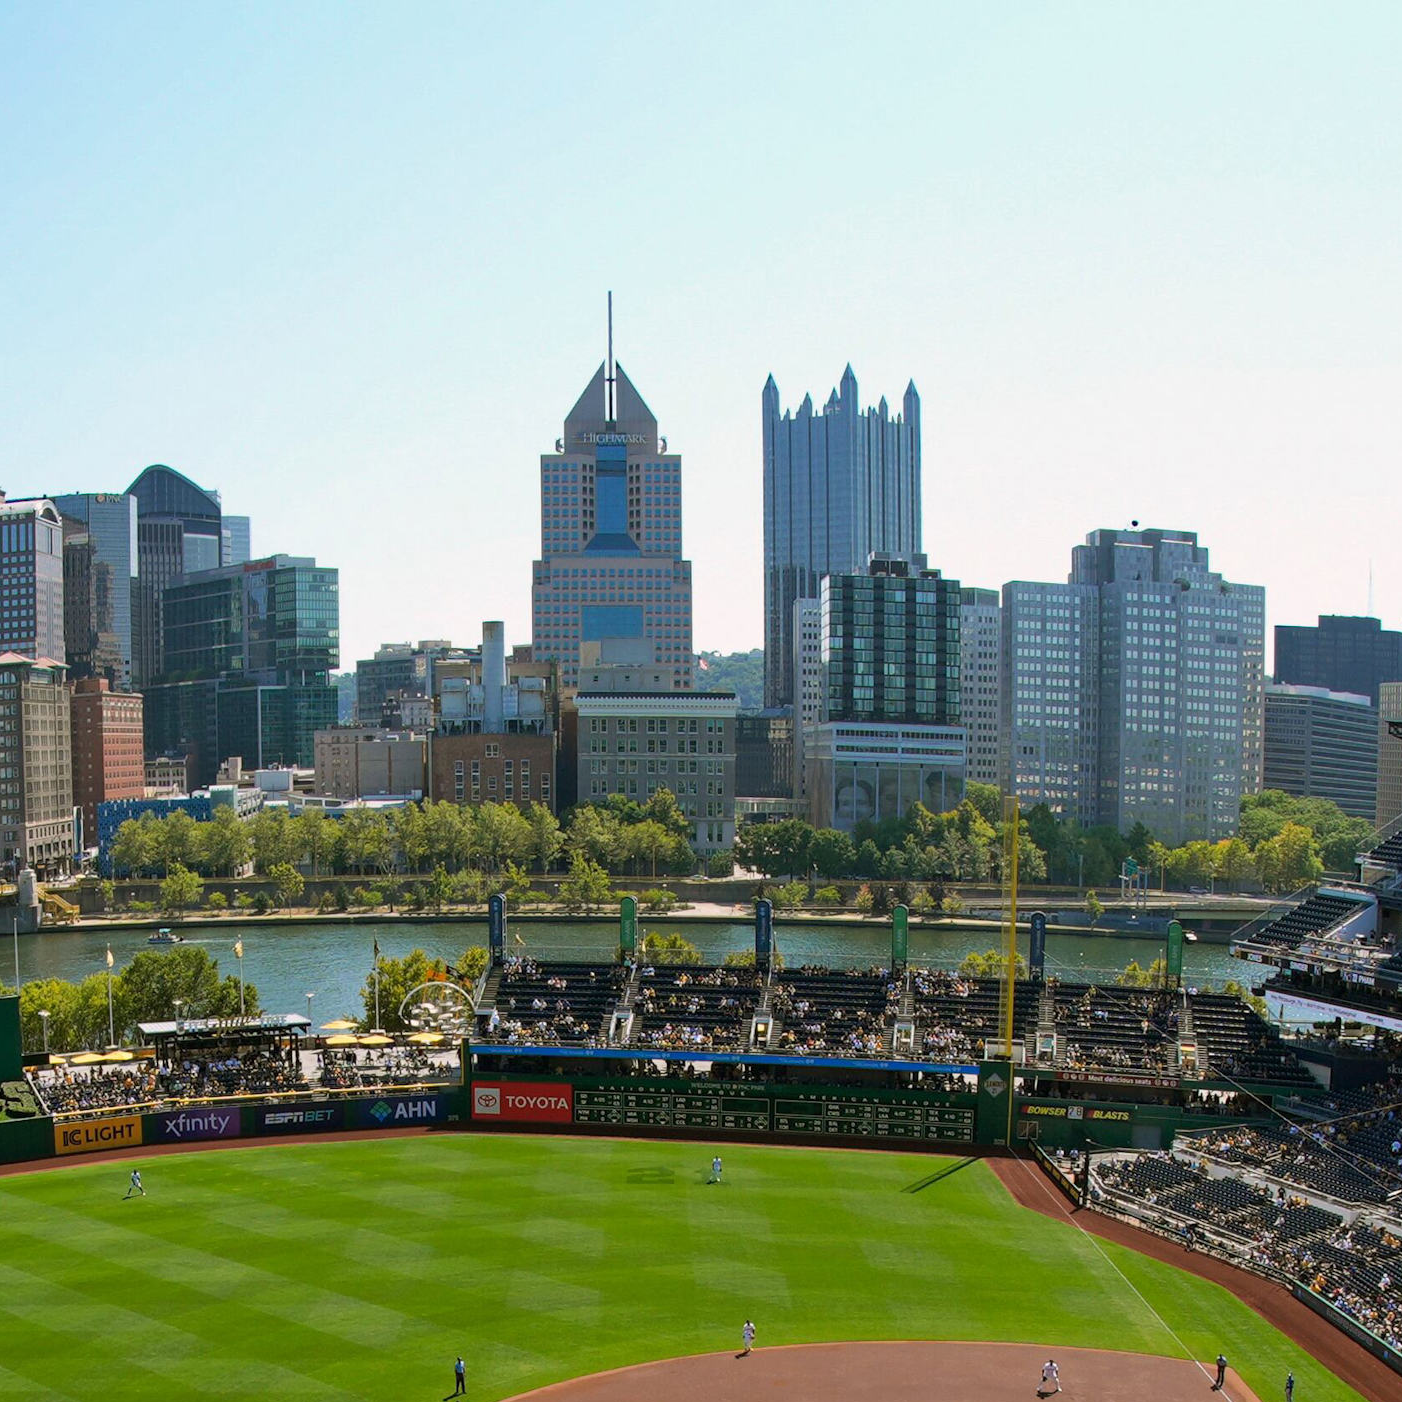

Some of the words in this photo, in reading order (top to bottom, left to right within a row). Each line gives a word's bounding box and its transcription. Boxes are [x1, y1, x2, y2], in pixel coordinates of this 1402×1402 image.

[1088, 1074, 1104, 1083] Most
[1104, 1075, 1135, 1086] delicious
[1134, 1078, 1152, 1086] seats
[598, 1085, 676, 1095] NATIONAL
[687, 1089, 746, 1097] LEAGUE
[505, 1094, 569, 1110] TOYOTA
[798, 1094, 880, 1104] AMERICAN
[891, 1099, 951, 1108] LEAGUE
[394, 1100, 437, 1119] AHN
[1026, 1105, 1067, 1117] BOWSER
[1092, 1110, 1130, 1121] BLASTS
[164, 1110, 231, 1138] xfinity
[63, 1126, 81, 1146] IC
[85, 1122, 135, 1144] LIGHT
